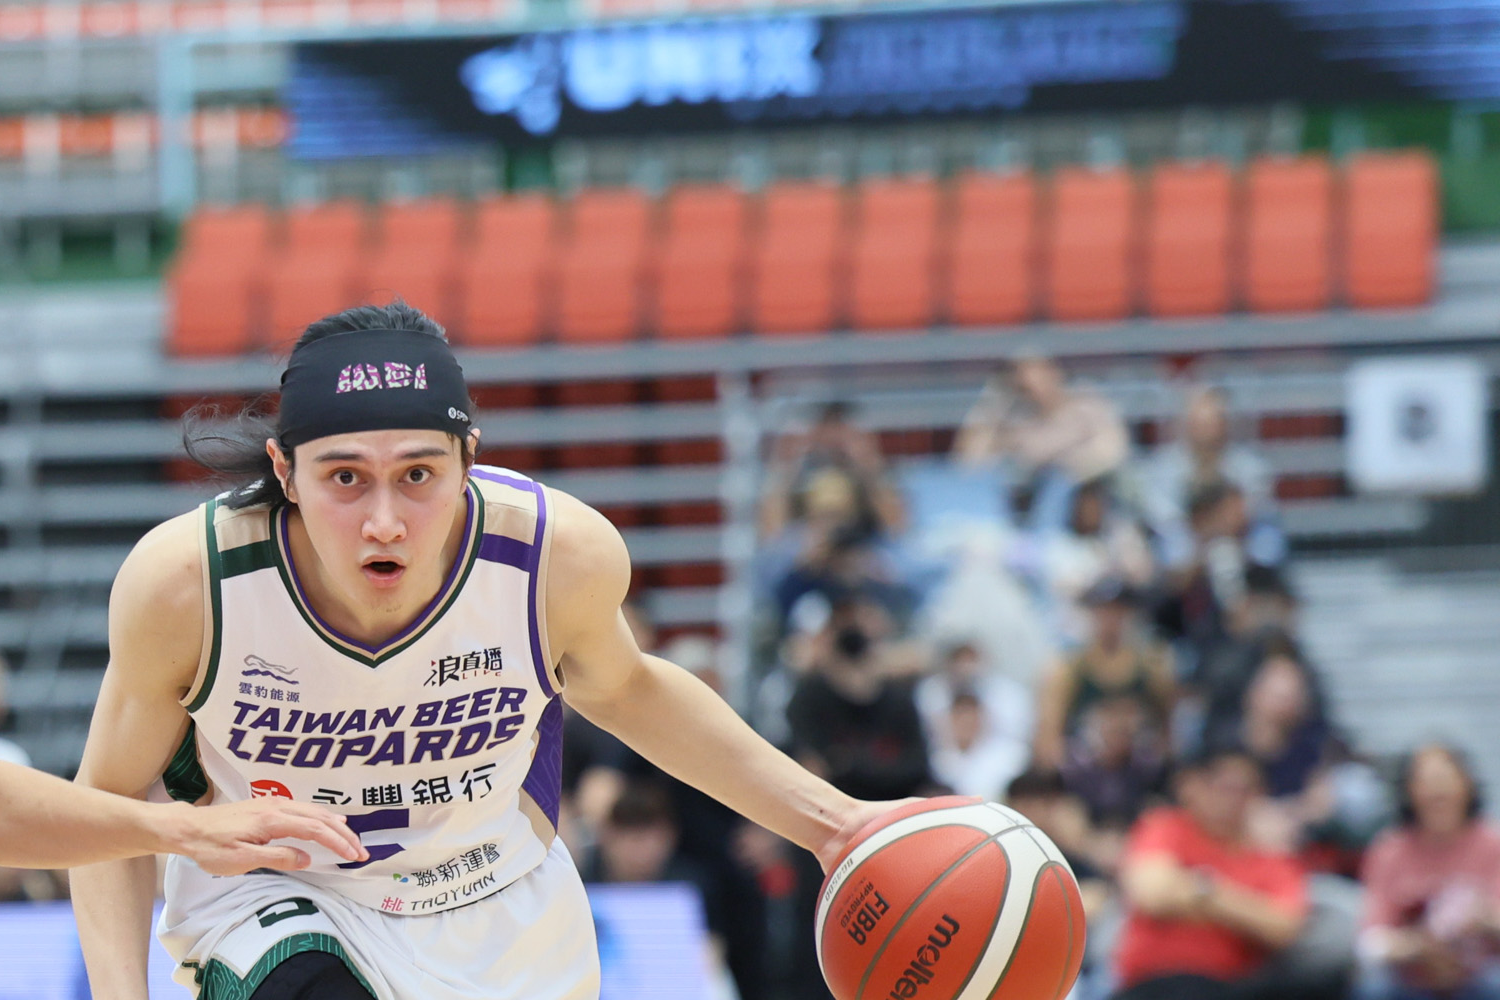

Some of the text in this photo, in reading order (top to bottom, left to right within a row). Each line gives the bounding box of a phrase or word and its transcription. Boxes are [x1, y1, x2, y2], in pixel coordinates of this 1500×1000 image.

[423, 647, 503, 687] 浪直播
[233, 686, 528, 735] TAIWAN BEER
[238, 681, 300, 703] 雲豹能源
[227, 714, 526, 769] LEOPARDS
[840, 881, 874, 928] APPROVED
[847, 890, 890, 946] FIBA
